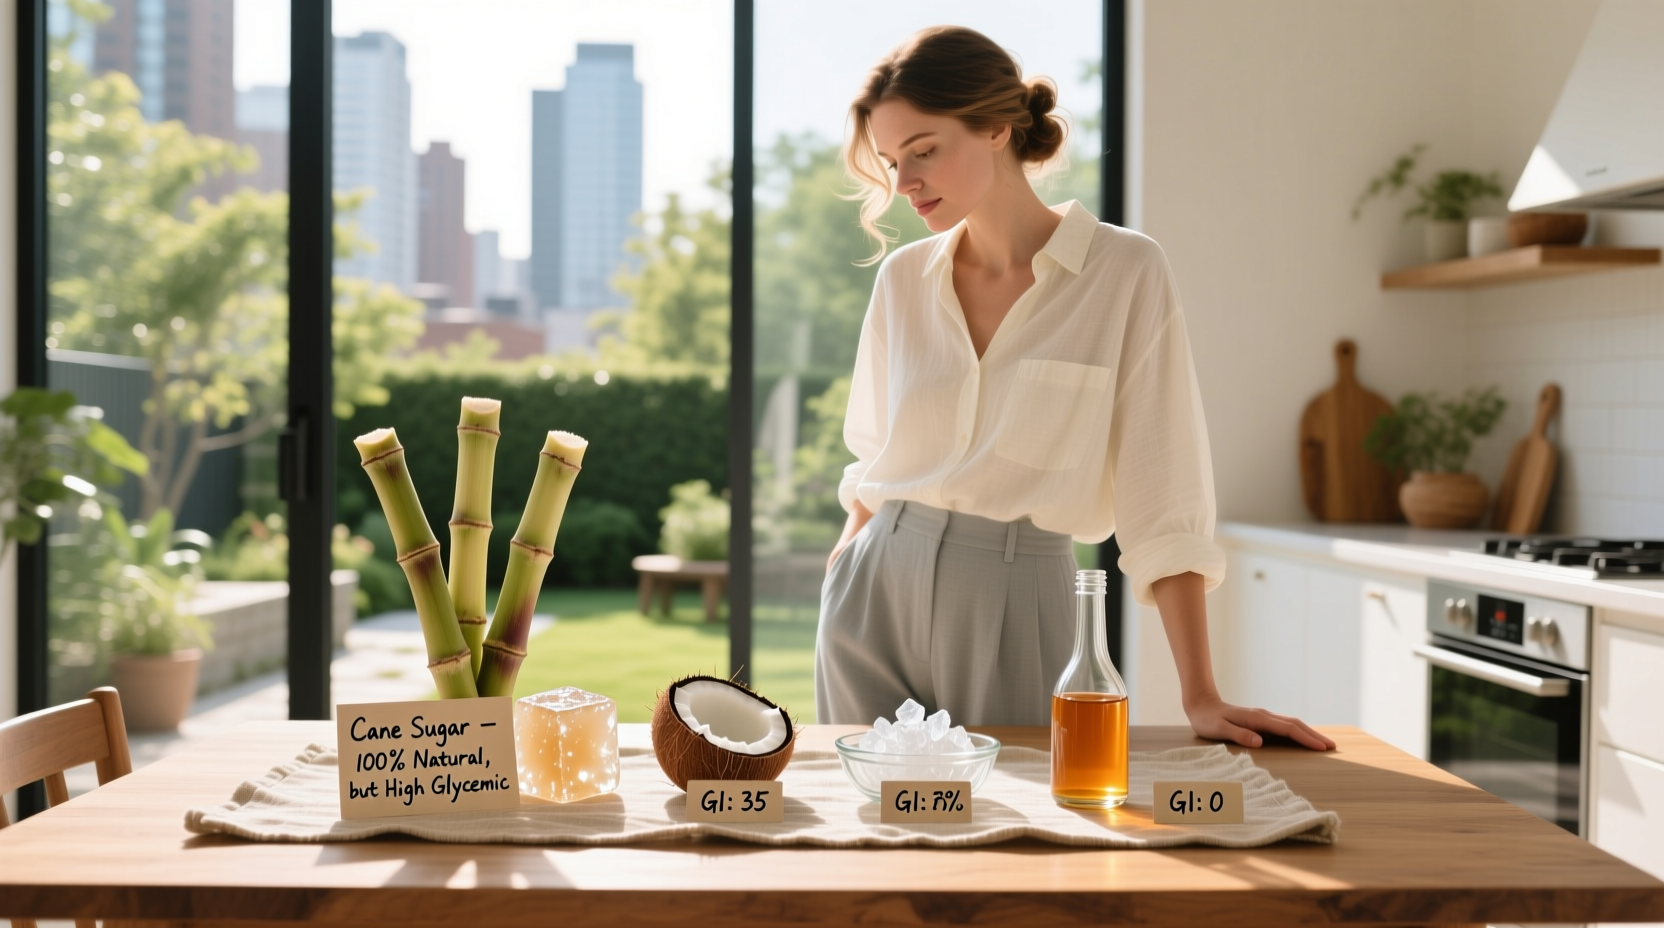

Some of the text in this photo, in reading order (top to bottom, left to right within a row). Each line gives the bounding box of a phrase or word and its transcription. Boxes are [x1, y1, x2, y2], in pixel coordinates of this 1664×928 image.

[350, 716, 403, 742] Cane
[410, 715, 470, 748] Sugar
[356, 746, 491, 773] 100% Natural,
[349, 773, 510, 807] but High Glycemic
[700, 789, 770, 814] GI: 35
[894, 789, 927, 814] GI:
[1169, 789, 1225, 816] GI: 0
